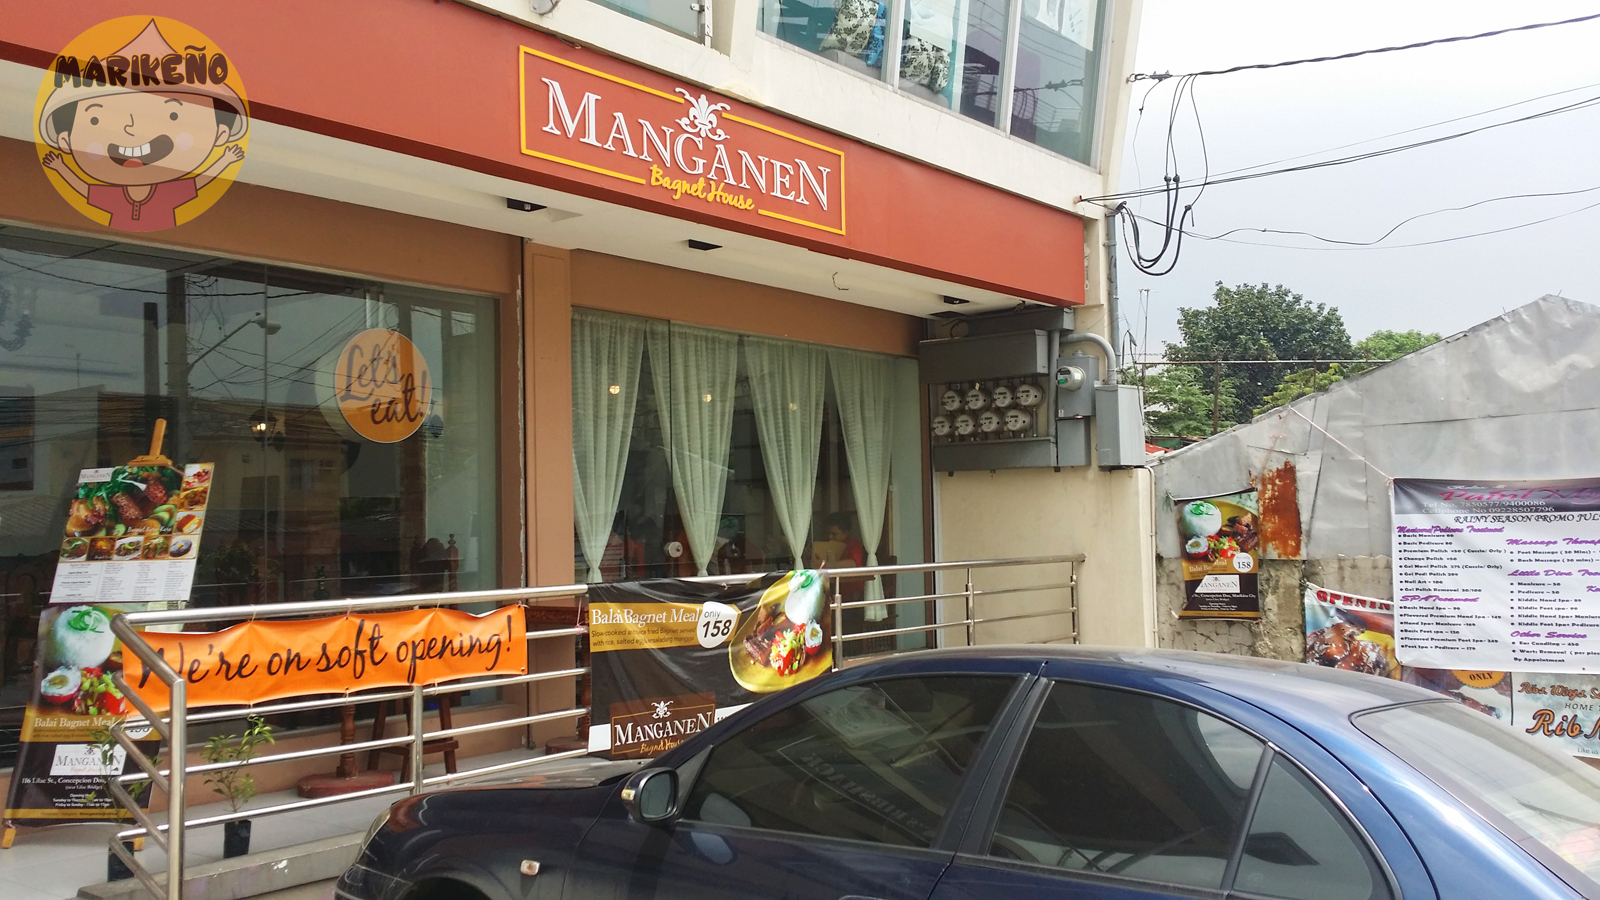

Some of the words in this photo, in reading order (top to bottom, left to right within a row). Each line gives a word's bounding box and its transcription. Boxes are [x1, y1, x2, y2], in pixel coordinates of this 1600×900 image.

[541, 77, 831, 211] MANGANEN
[650, 164, 706, 200] Bagnet
[707, 180, 755, 210] House
[340, 343, 405, 403] Let's
[371, 370, 427, 425] eat!
[1453, 515, 1490, 524] RAINY
[1490, 514, 1534, 524] SEASON
[1534, 513, 1575, 523] PROMO
[1576, 513, 1600, 523] JUL
[1237, 561, 1252, 570] 158
[1316, 589, 1394, 611] OPENIN
[591, 609, 624, 625] Balai
[624, 609, 667, 628] Bagnet
[670, 607, 700, 623] Meal
[704, 610, 721, 620] only
[702, 619, 732, 639] 158
[267, 647, 312, 677] on
[315, 619, 388, 680] soft
[396, 614, 513, 685] opening!
[1469, 672, 1493, 681] ONLY
[1564, 702, 1595, 712] HOME
[34, 717, 57, 728] Balai
[59, 717, 90, 730] Bagnet
[92, 716, 115, 727] Meal
[614, 711, 713, 747] MANGANEN
[1525, 708, 1584, 738] Rib
